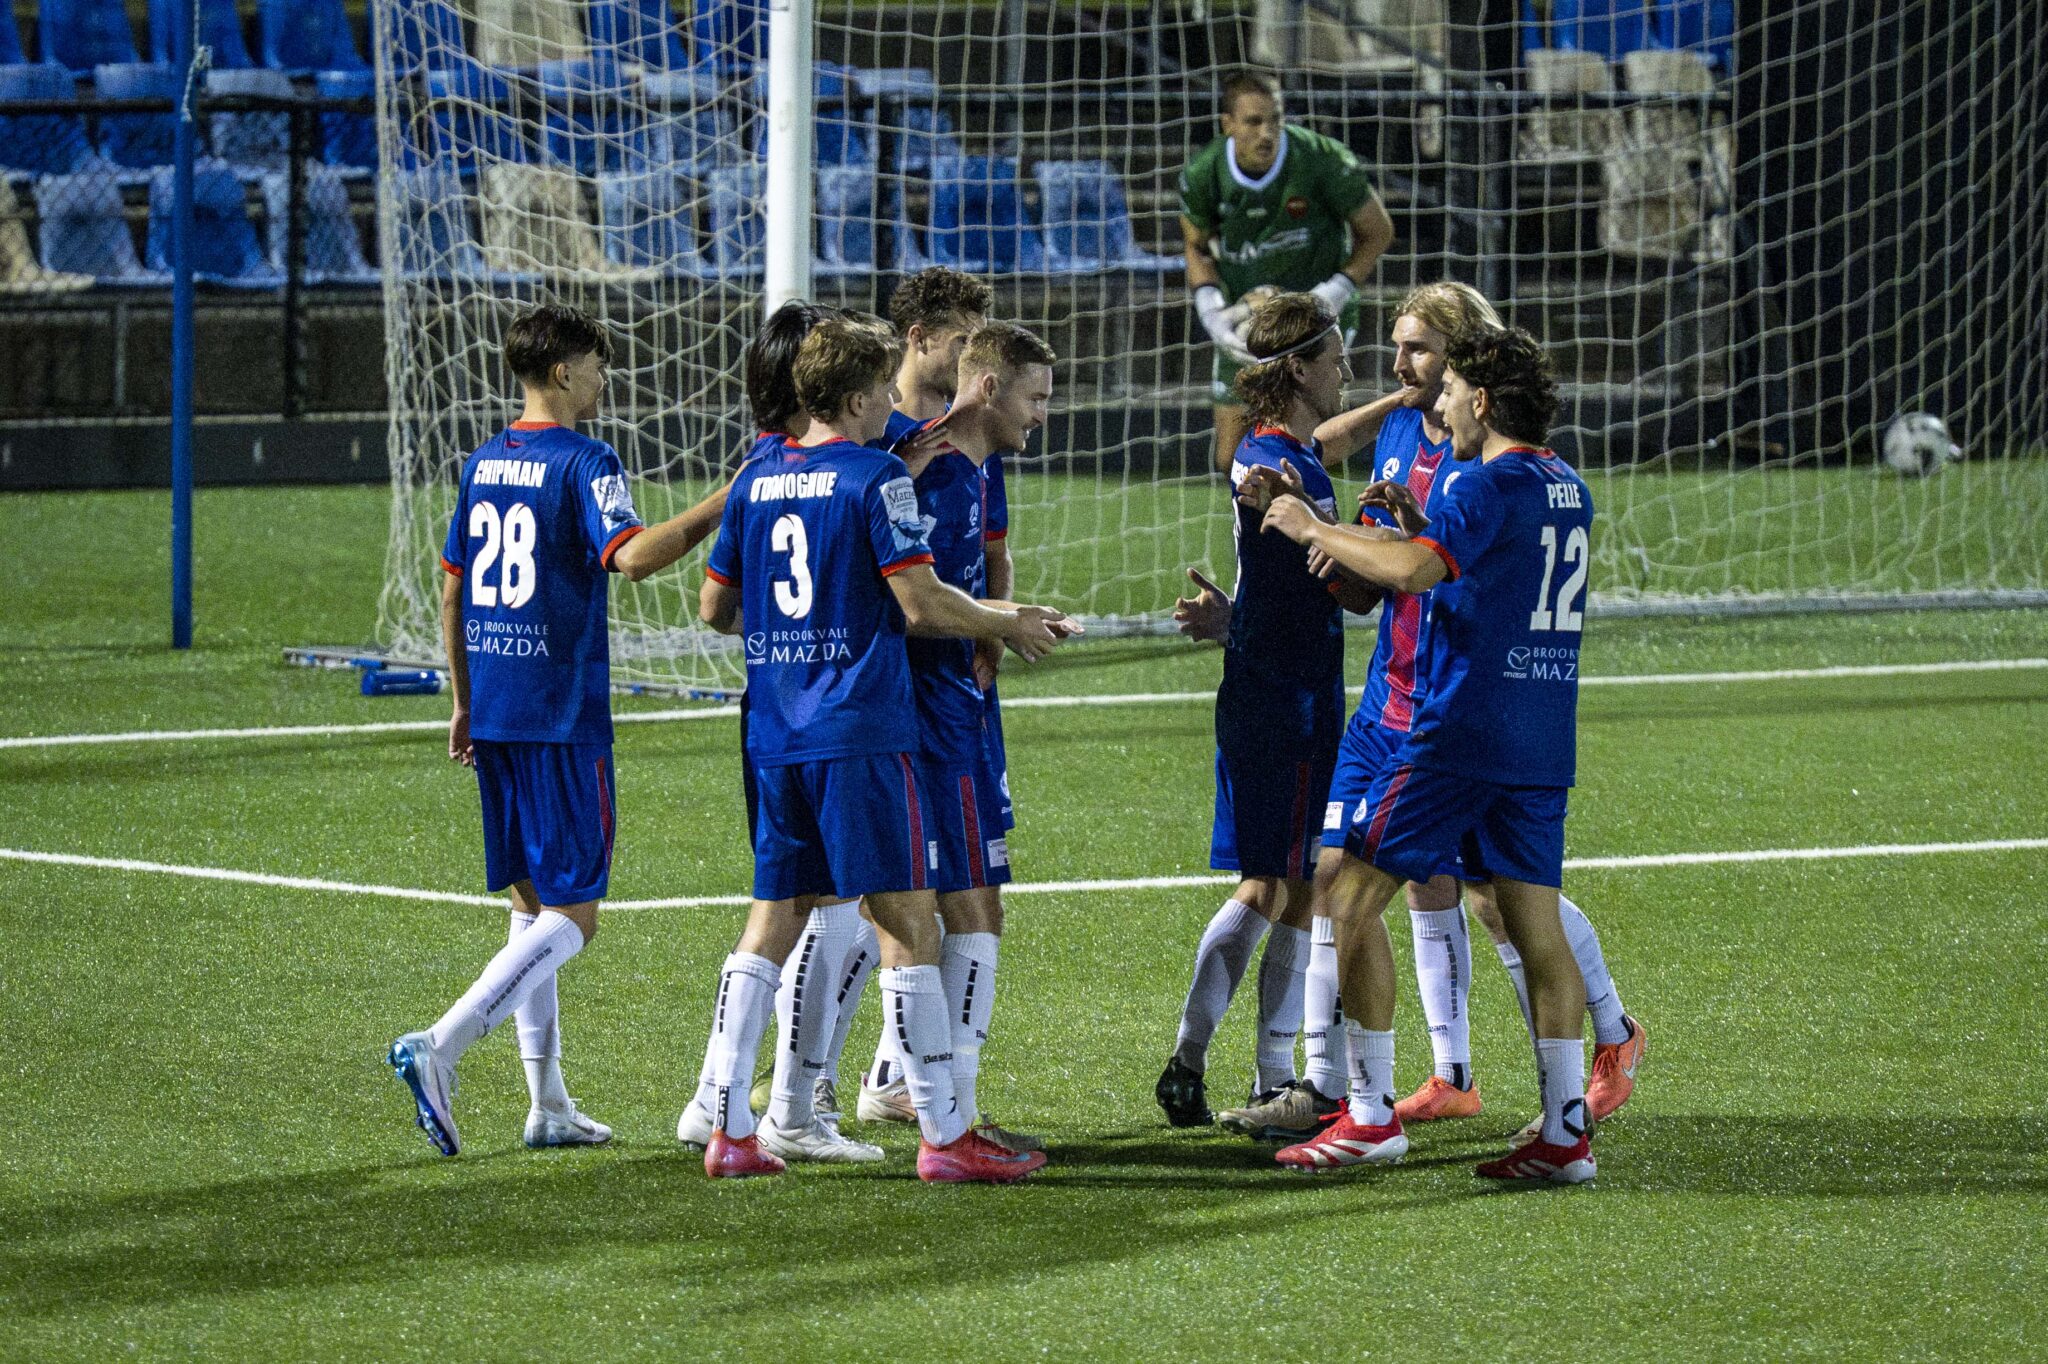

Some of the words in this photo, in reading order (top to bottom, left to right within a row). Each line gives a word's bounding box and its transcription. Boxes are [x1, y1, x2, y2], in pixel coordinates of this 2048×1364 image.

[473, 459, 547, 488] CHIPMAN
[1545, 483, 1582, 509] PELLE
[469, 501, 537, 609] 28
[771, 513, 813, 619] 3
[1530, 526, 1589, 631] 12
[481, 636, 550, 657] MAZDA
[772, 627, 850, 642] BROOKVALE
[771, 642, 852, 663] MAZDA
